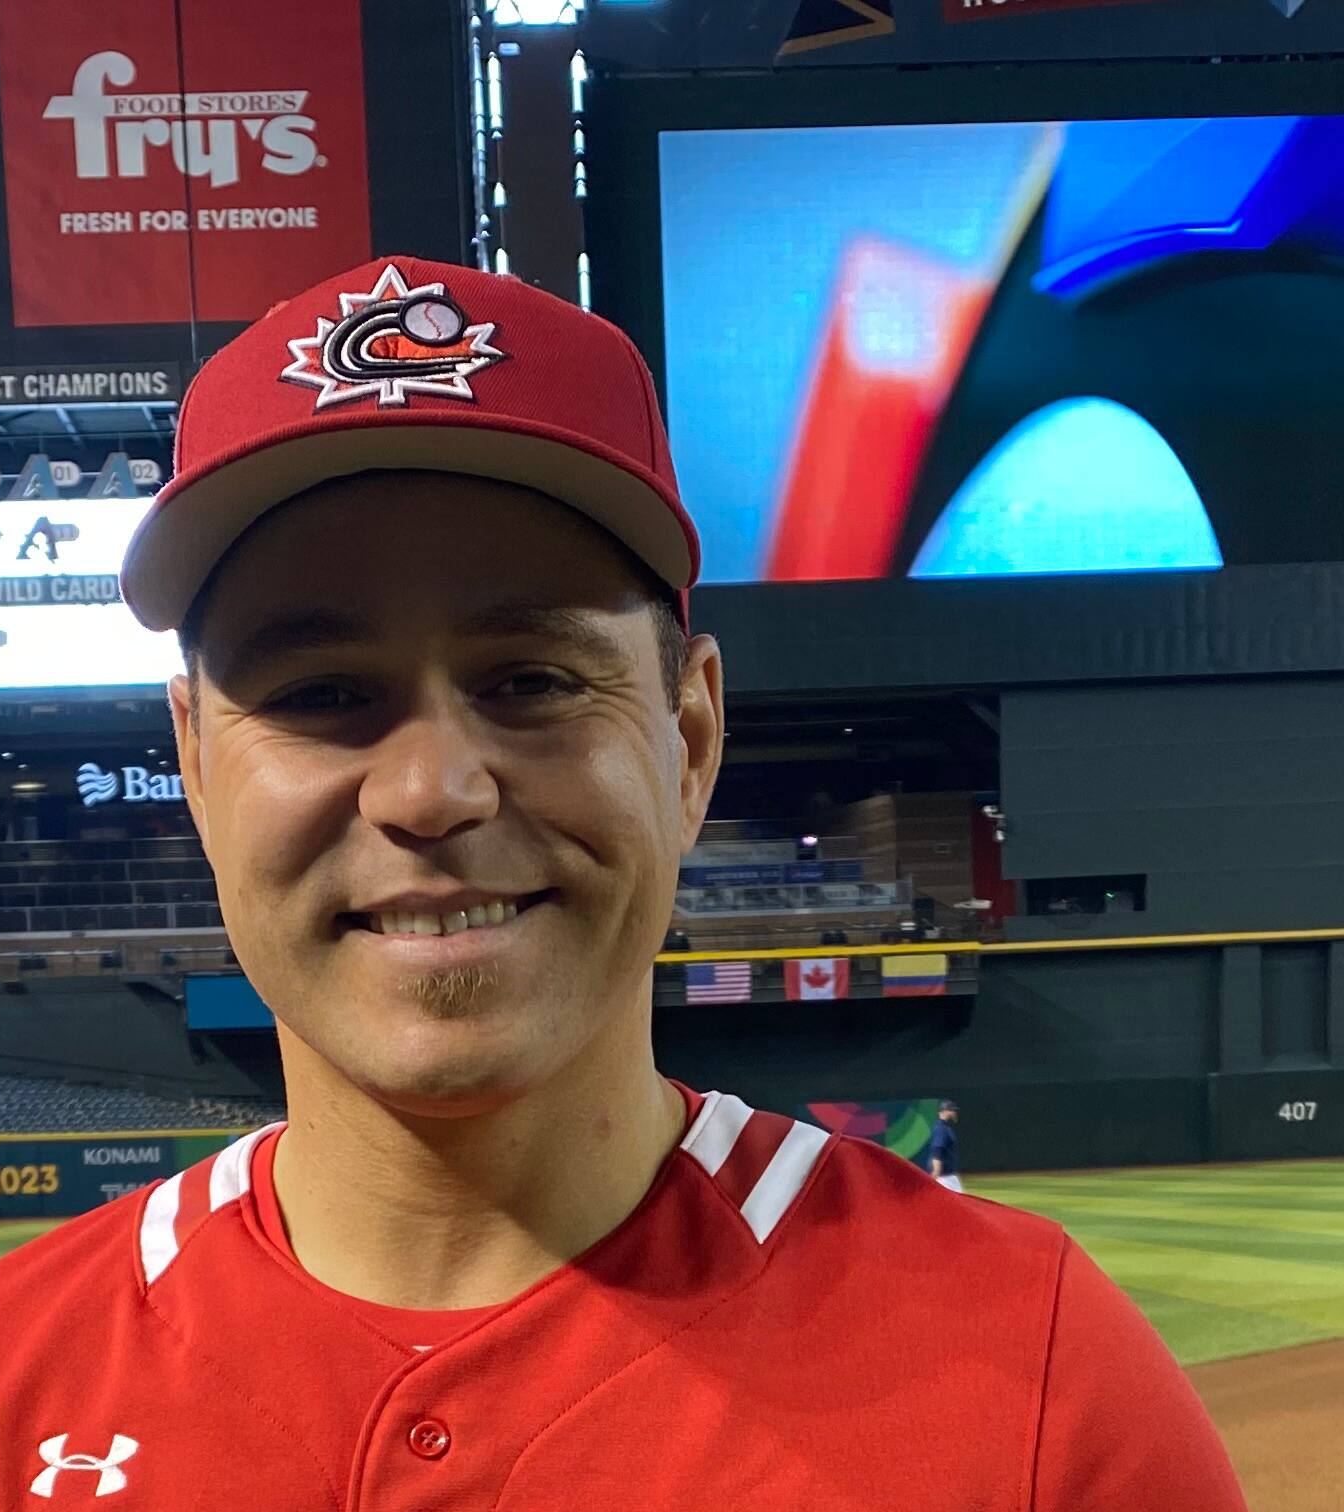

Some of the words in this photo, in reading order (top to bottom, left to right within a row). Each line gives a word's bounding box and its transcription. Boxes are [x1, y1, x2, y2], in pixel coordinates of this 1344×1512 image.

[112, 96, 185, 115] FOOD
[197, 93, 299, 113] STORES
[43, 51, 318, 188] fry's
[59, 210, 133, 234] FRESH
[139, 209, 189, 232] FOR
[197, 206, 319, 230] EVERYONE
[22, 371, 169, 398] CHAMPIONS
[53, 464, 74, 481] 01
[130, 463, 153, 479] 02
[50, 577, 116, 600] CARD
[1278, 1101, 1318, 1121] 407
[83, 1146, 161, 1166] KONAMI
